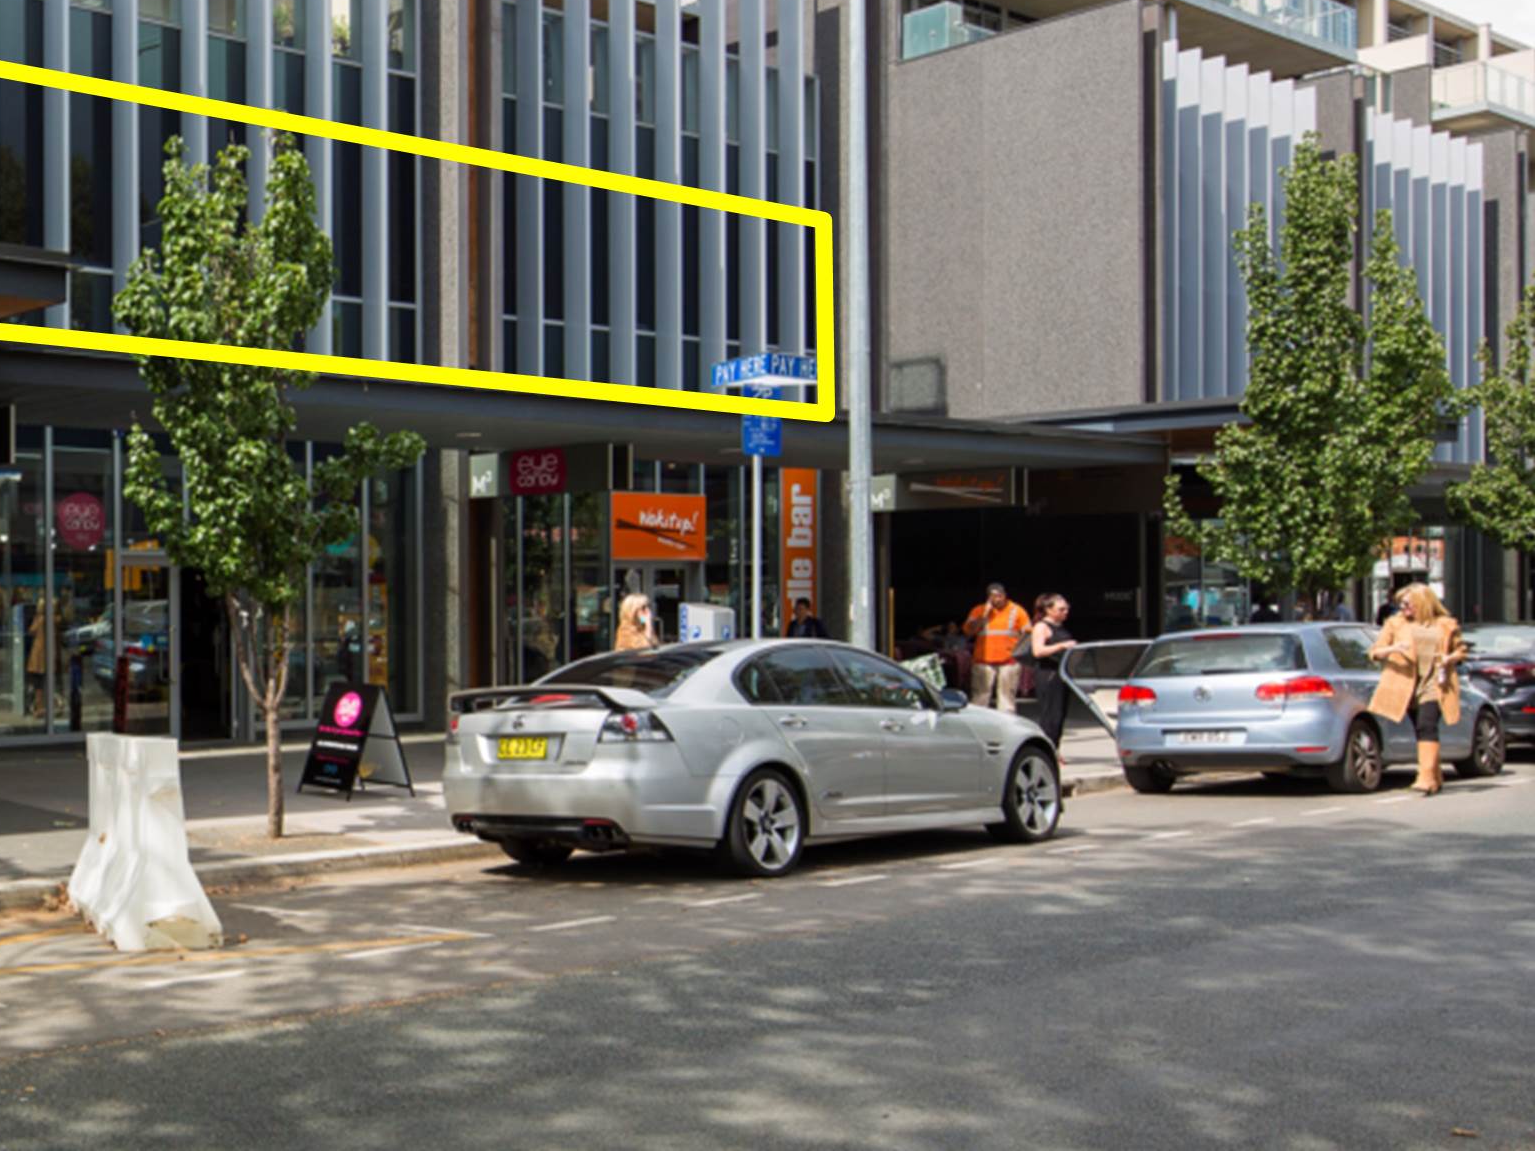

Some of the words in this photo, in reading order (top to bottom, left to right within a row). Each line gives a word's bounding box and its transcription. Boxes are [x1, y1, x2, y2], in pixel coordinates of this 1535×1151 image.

[715, 364, 736, 386] PAY
[740, 353, 767, 380] HERE
[770, 352, 795, 379] PAY
[799, 357, 818, 379] HE
[786, 483, 813, 547] bar
